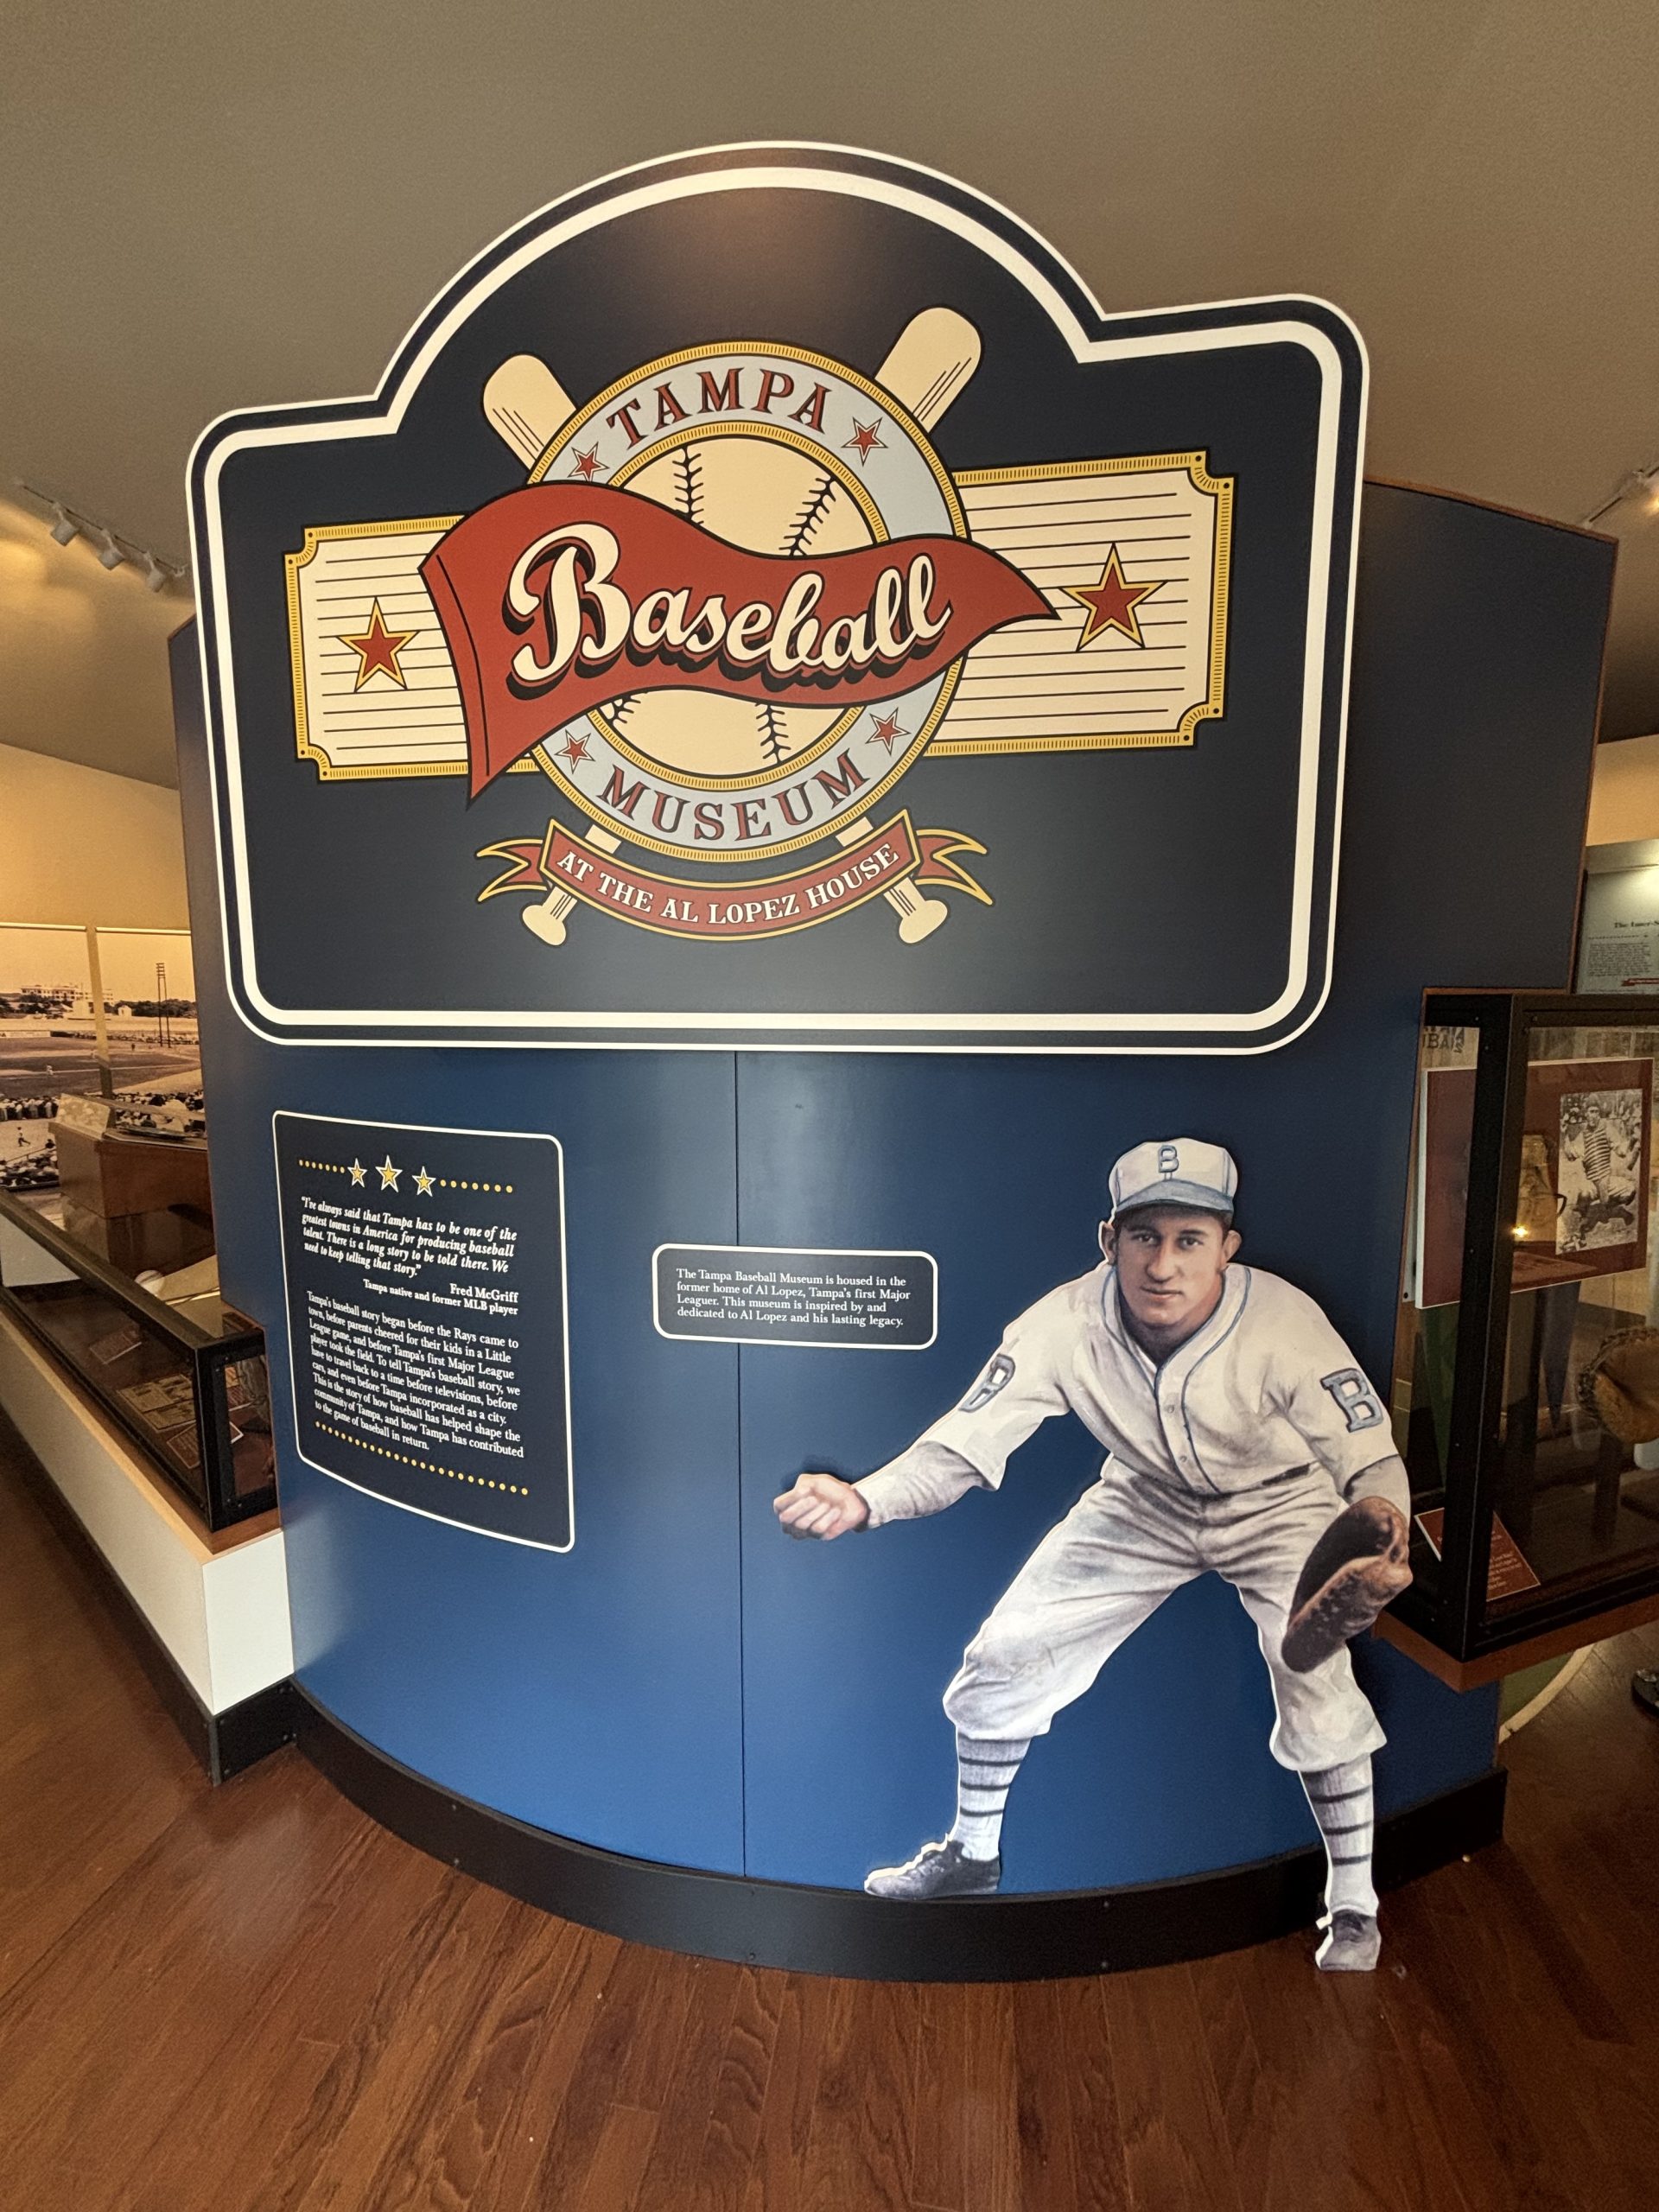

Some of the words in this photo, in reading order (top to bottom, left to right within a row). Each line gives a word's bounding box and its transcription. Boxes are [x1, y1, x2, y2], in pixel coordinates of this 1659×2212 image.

[606, 366, 833, 450] TAMPA
[505, 523, 953, 693] Baseball
[597, 749, 868, 842] MUSEUM
[556, 849, 594, 882] AT
[596, 872, 655, 912] THE
[660, 898, 698, 923] AL
[709, 893, 800, 925] LOPEZ
[804, 843, 899, 910] HOUSE
[1158, 1145, 1179, 1174] B
[302, 1214, 327, 1226] greatest
[328, 1219, 351, 1231] towns
[353, 1224, 361, 1234] in
[363, 1225, 398, 1241] America
[399, 1230, 415, 1245] for
[416, 1236, 467, 1255] producing
[468, 1240, 515, 1256] baseball
[318, 1201, 342, 1217] always
[344, 1208, 360, 1218] said
[363, 1210, 381, 1223] that
[382, 1212, 413, 1230] Tampa
[416, 1217, 433, 1230] has
[436, 1222, 446, 1232] to
[449, 1222, 460, 1234] be
[463, 1227, 481, 1236] one
[485, 1226, 498, 1242] of
[499, 1227, 518, 1241] the
[304, 1243, 319, 1253] need
[321, 1246, 327, 1255] to
[328, 1246, 344, 1262] keep
[346, 1252, 371, 1269] telling
[373, 1257, 391, 1270] that
[326, 1231, 347, 1246] There
[349, 1237, 356, 1248] is
[366, 1240, 385, 1257] long
[387, 1247, 410, 1262] story
[411, 1250, 421, 1260] to
[423, 1249, 434, 1262] be
[437, 1253, 458, 1266] told
[461, 1255, 489, 1270] there.
[492, 1259, 508, 1273] We
[363, 1279, 388, 1294] Tampa
[389, 1287, 412, 1298] native
[415, 1292, 430, 1301] and
[432, 1293, 461, 1306] former
[463, 1298, 487, 1310] MLB
[489, 1302, 518, 1316] player
[449, 1283, 473, 1297] Fred
[474, 1287, 518, 1303] McGriff
[676, 1268, 696, 1278] The
[698, 1269, 732, 1283] Tampa
[735, 1271, 777, 1282] Baseball
[779, 1273, 823, 1284] Museum
[825, 1275, 834, 1284] is
[836, 1274, 873, 1285] housed
[890, 1276, 906, 1286] the
[677, 1281, 710, 1292] former
[713, 1282, 740, 1294] home
[741, 1284, 753, 1294] of
[755, 1285, 768, 1294] Al
[772, 1286, 806, 1299] Lopez,
[808, 1287, 851, 1300] Tampa's
[855, 1288, 876, 1298] first
[880, 1289, 911, 1301] Major
[333, 1299, 359, 1316] baseball
[361, 1310, 380, 1324] story
[382, 1313, 406, 1329] began
[408, 1319, 435, 1334] before
[436, 1325, 452, 1337] the
[454, 1327, 477, 1344] Rays
[480, 1336, 505, 1346] came
[508, 1338, 518, 1348] to
[677, 1294, 719, 1307] Leaguer.
[722, 1296, 746, 1306] This
[793, 1300, 802, 1309] is
[805, 1300, 848, 1313] inspired
[850, 1301, 863, 1313] by
[867, 1302, 887, 1312] and
[677, 1306, 725, 1319] dedicated
[740, 1310, 753, 1319] Al
[756, 1310, 787, 1324] Lopez
[790, 1313, 810, 1322] and
[812, 1313, 829, 1323] his
[831, 1313, 866, 1327] lasting
[869, 1314, 904, 1327] legacy.
[326, 1310, 346, 1325] before
[347, 1320, 372, 1333] parents
[374, 1325, 404, 1342] cheered
[406, 1333, 418, 1345] for
[421, 1337, 442, 1350] their
[443, 1340, 462, 1355] kids
[465, 1345, 475, 1357] in
[485, 1348, 512, 1363] Little
[353, 1336, 366, 1346] and
[368, 1338, 391, 1353] before
[392, 1344, 425, 1362] Tampa's
[427, 1352, 445, 1366] first
[448, 1357, 475, 1373] Major
[478, 1363, 515, 1381] League
[329, 1341, 344, 1352] took
[345, 1344, 356, 1357] the
[357, 1349, 374, 1363] field.
[376, 1354, 387, 1366] To
[389, 1359, 402, 1370] tell
[403, 1361, 435, 1379] Tampa's
[438, 1370, 475, 1387] baseball
[478, 1381, 504, 1395] story,
[506, 1386, 520, 1395] we
[353, 1361, 369, 1375] back
[371, 1369, 378, 1377] to
[387, 1373, 404, 1385] time
[406, 1376, 433, 1393] before
[435, 1385, 484, 1406] televisions,
[486, 1395, 518, 1410] before
[313, 1372, 327, 1386] This
[334, 1382, 344, 1393] the
[346, 1389, 362, 1402] story
[363, 1394, 372, 1403] of
[372, 1395, 389, 1408] how
[390, 1400, 423, 1419] baseball
[425, 1410, 440, 1424] has
[442, 1414, 472, 1432] helped
[474, 1423, 502, 1440] shape
[505, 1429, 521, 1441] the
[357, 1376, 380, 1392] before
[380, 1383, 407, 1402] Tampa
[410, 1393, 465, 1415] incorporated
[467, 1409, 477, 1418] as
[487, 1412, 506, 1427] city.
[1320, 1367, 1384, 1433] B
[356, 1403, 383, 1422] Tampa,
[385, 1416, 399, 1427] and
[401, 1418, 418, 1432] how
[420, 1423, 449, 1442] Tampa
[452, 1432, 467, 1445] has
[468, 1440, 524, 1458] contributed
[360, 1418, 390, 1437] baseball
[391, 1430, 400, 1440] in
[402, 1436, 429, 1450] return.
